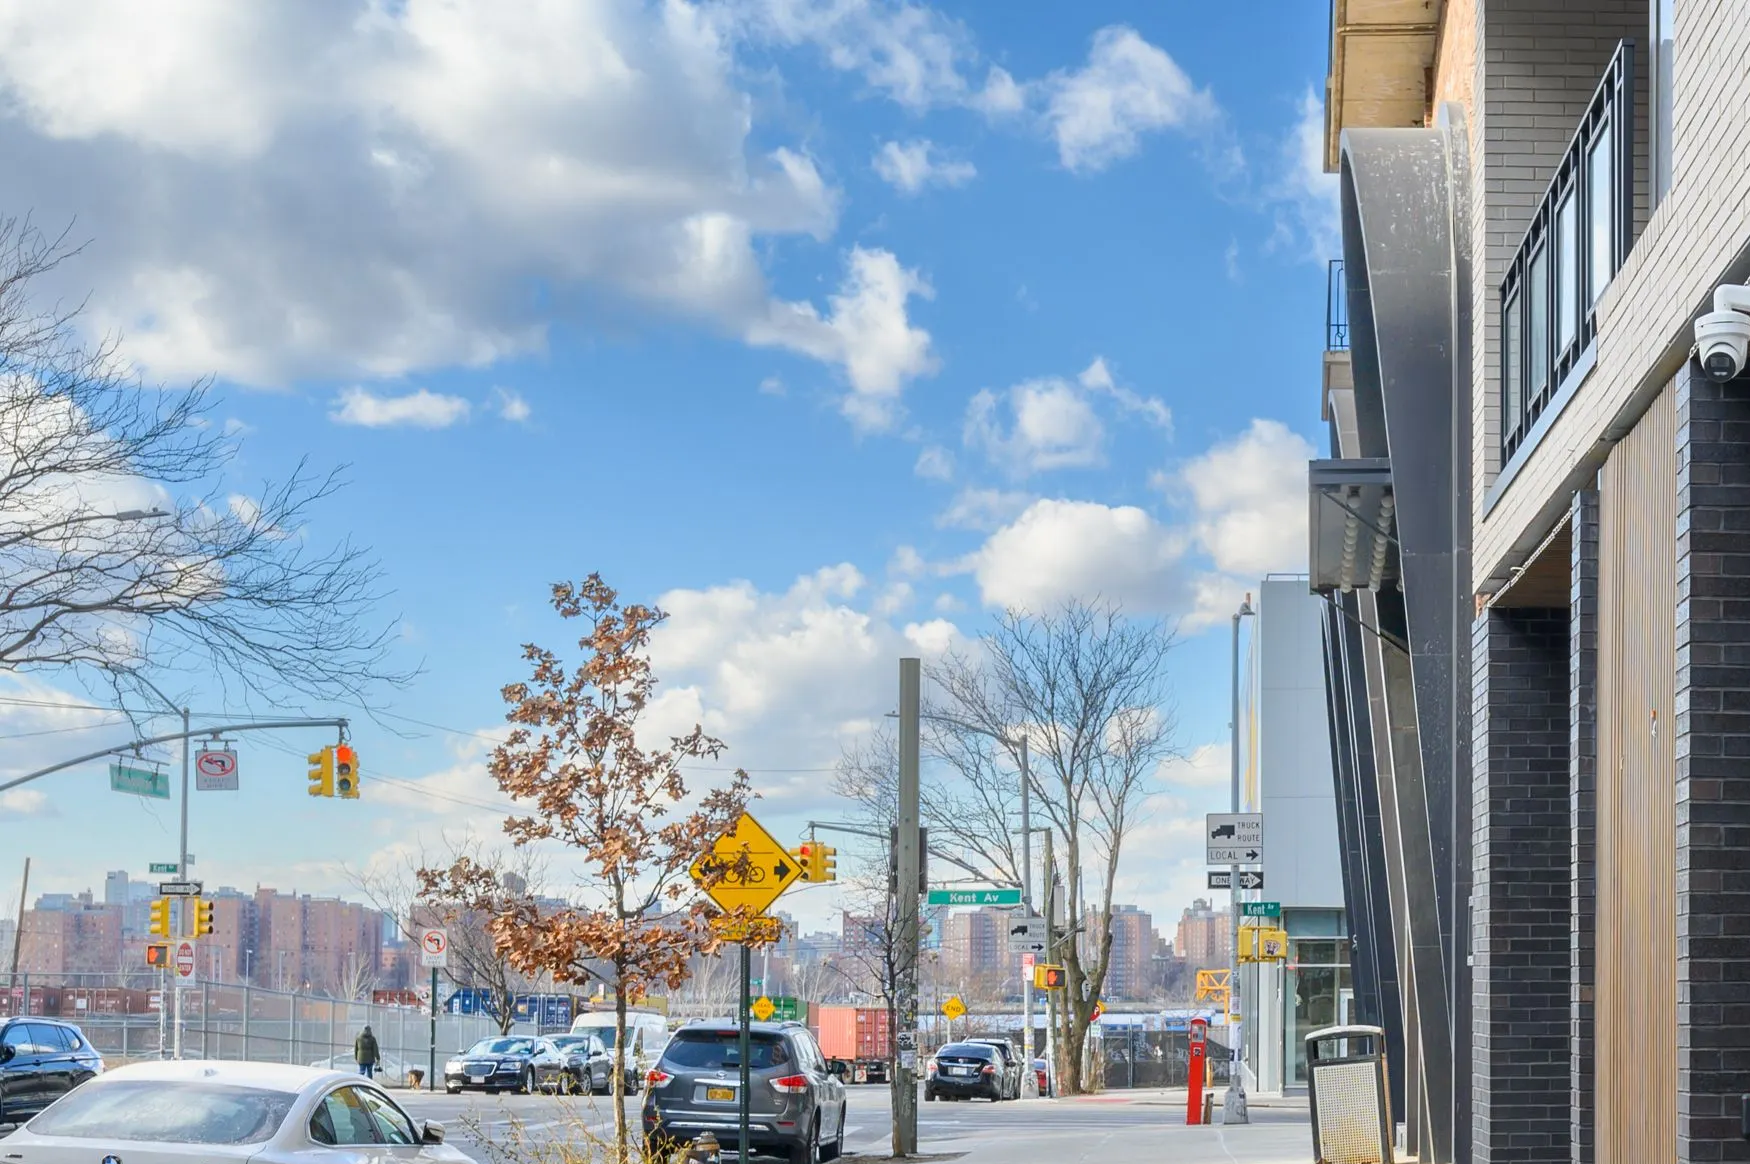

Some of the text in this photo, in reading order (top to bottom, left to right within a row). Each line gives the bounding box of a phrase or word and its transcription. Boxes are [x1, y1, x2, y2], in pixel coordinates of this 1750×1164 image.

[1237, 821, 1260, 829] TRUCK
[1237, 834, 1260, 842] ROUTE
[1210, 851, 1238, 860] LOCAL
[1215, 876, 1256, 885] ONE WAY
[949, 893, 999, 903] Kent Av
[1247, 904, 1265, 915] Kent
